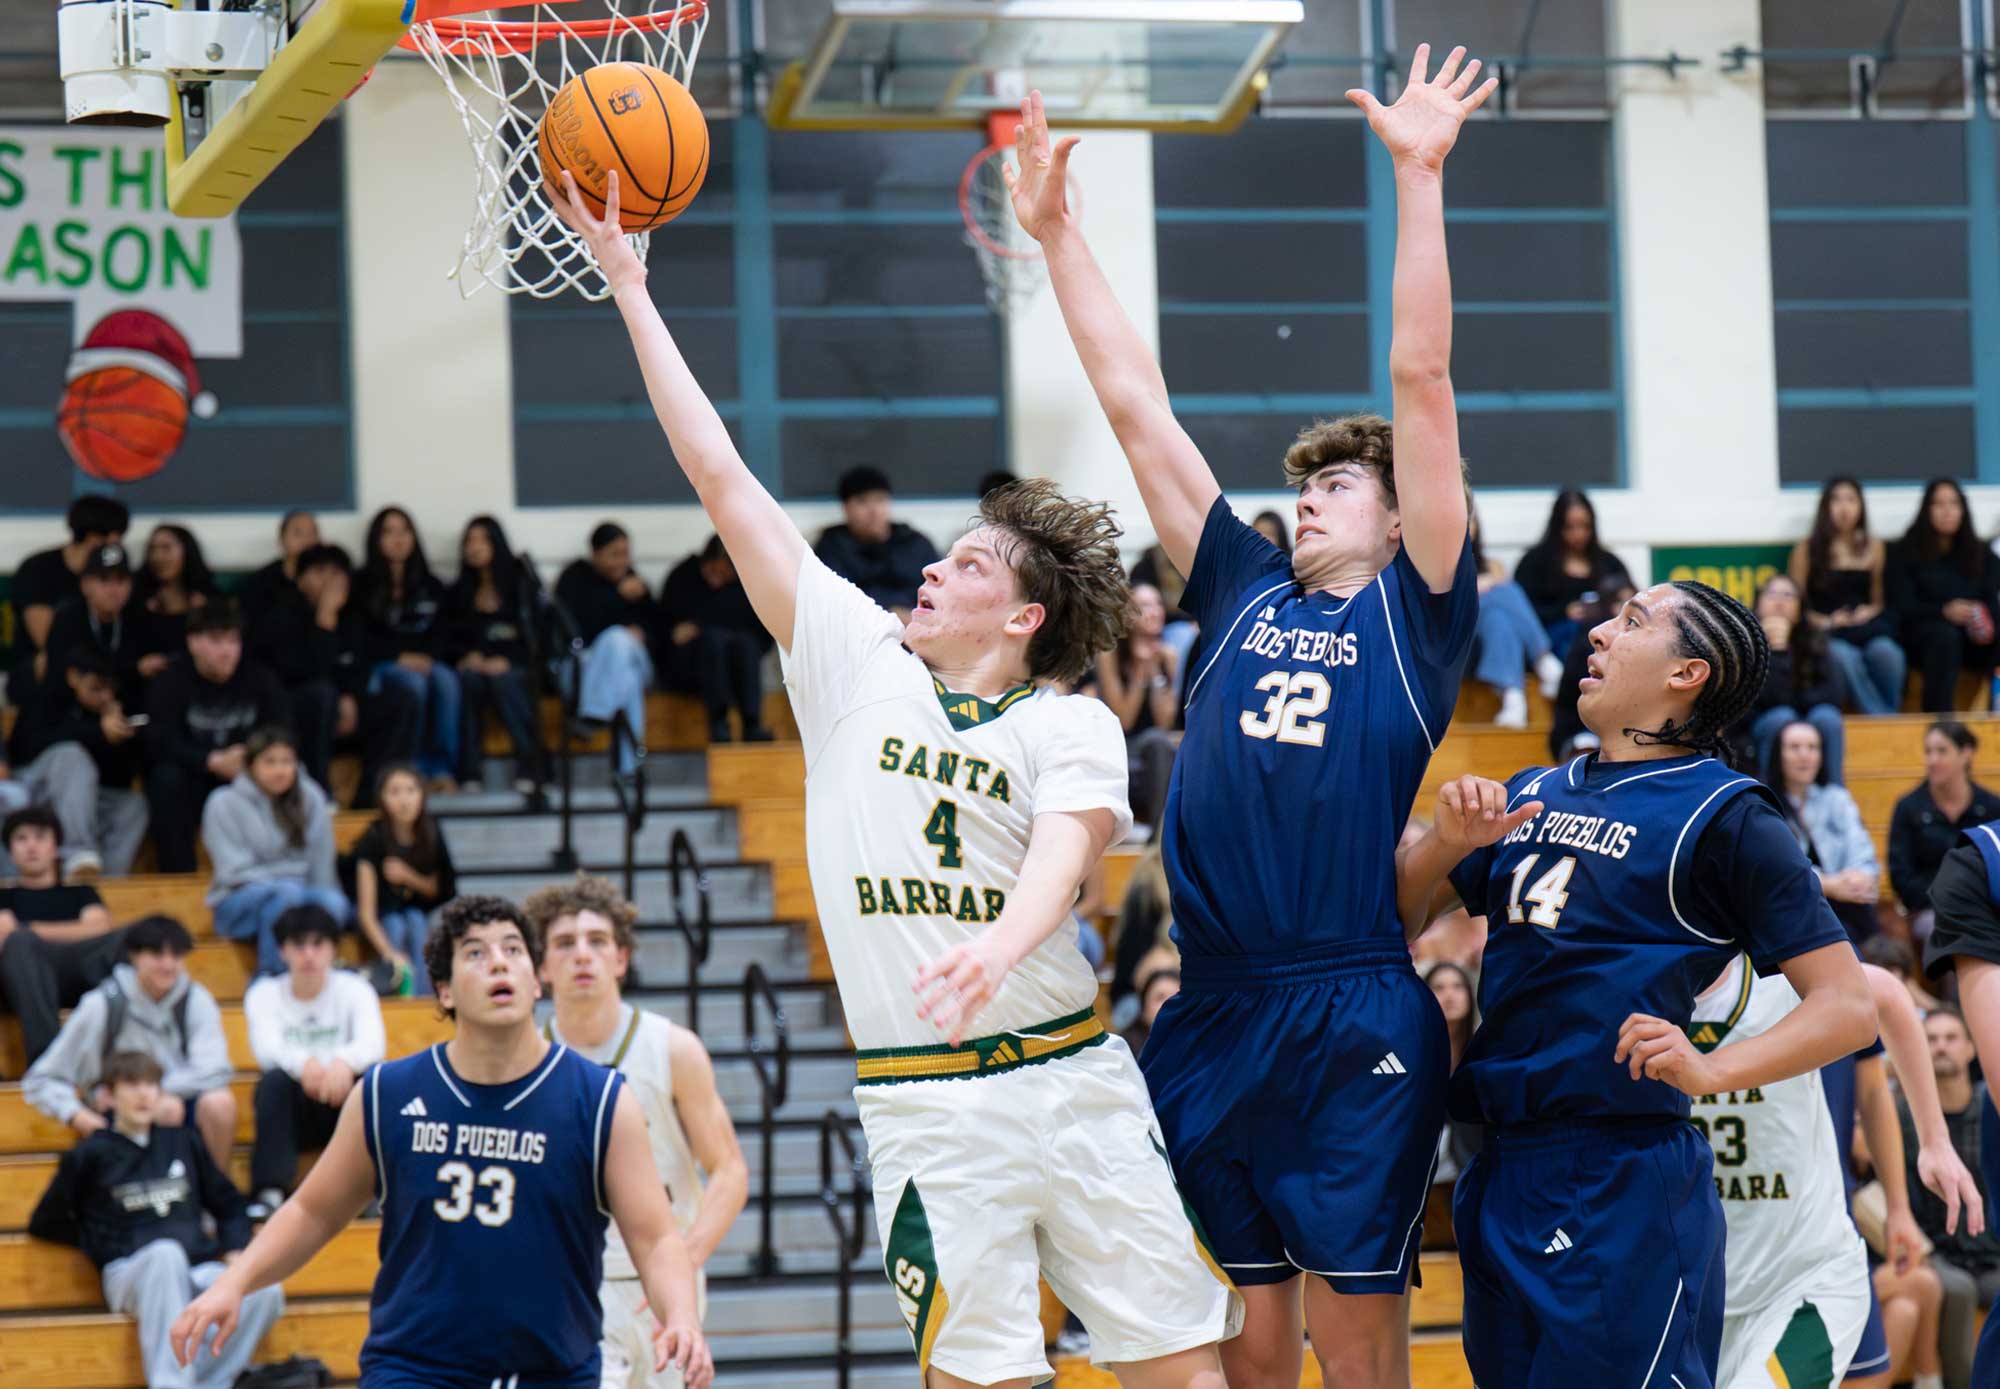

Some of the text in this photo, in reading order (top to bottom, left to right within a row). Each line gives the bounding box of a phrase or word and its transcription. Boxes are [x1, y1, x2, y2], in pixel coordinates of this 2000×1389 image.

[54, 145, 170, 211] TH
[3, 220, 212, 294] ASON
[1240, 620, 1293, 660] DOS
[1239, 670, 1332, 748] 32
[879, 737, 1013, 804] SANTA
[922, 797, 964, 870] 4
[1535, 811, 1638, 860] PUEBLOS
[854, 875, 1006, 923] BARBAR
[1506, 853, 1577, 930] 14
[411, 1121, 547, 1164] DOS PUEBLOS
[434, 1160, 516, 1227] 33
